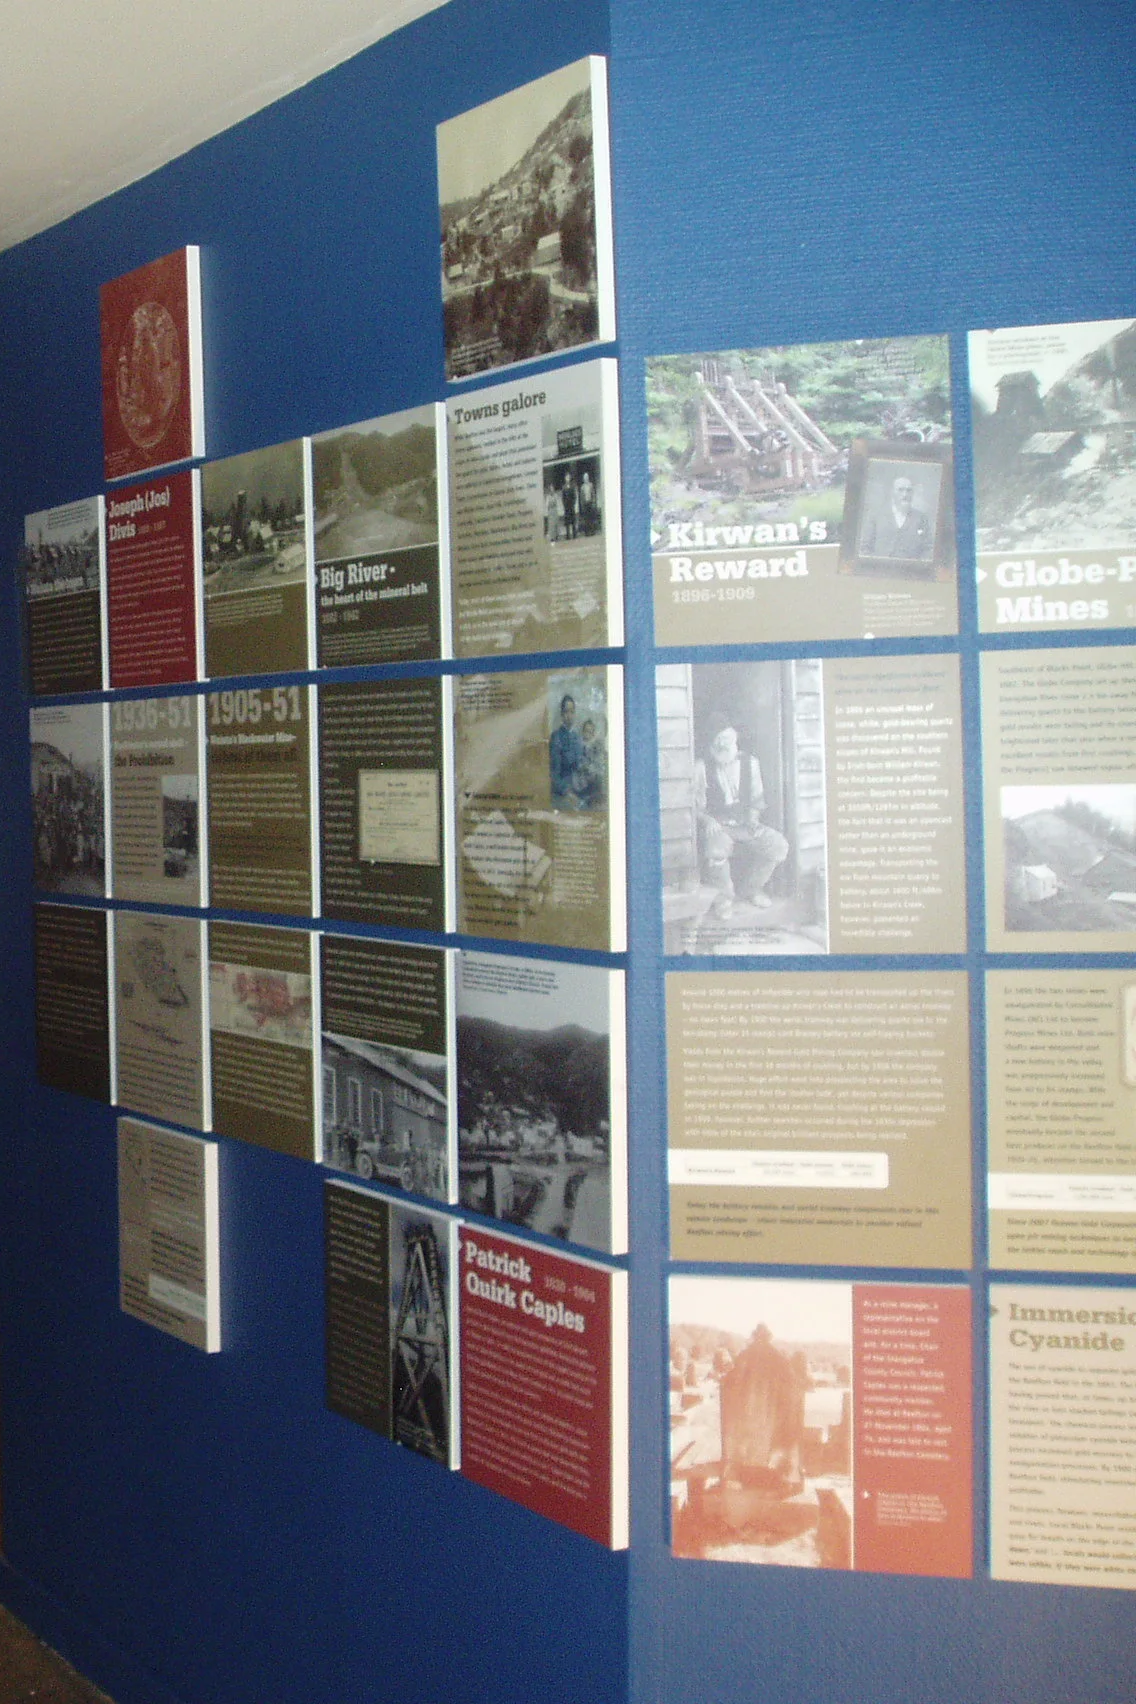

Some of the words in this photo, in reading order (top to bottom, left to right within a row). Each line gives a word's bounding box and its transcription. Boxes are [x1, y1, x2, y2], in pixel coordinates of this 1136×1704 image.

[455, 403, 499, 425] Towns
[503, 391, 546, 418] galore
[109, 494, 144, 518] Joseph
[109, 520, 137, 541] Divis
[668, 516, 828, 548] Kirwan's
[320, 566, 344, 592] Big
[347, 562, 388, 584] River
[669, 550, 809, 582] Reward
[672, 587, 756, 604] 1896-1909
[995, 595, 1109, 624] Mines
[112, 696, 192, 731] 1936-51
[209, 685, 301, 725] 1905-51
[465, 1240, 532, 1284] Patrick
[465, 1271, 517, 1310] Quirk
[520, 1290, 585, 1334] Caples
[1009, 1329, 1126, 1352] Cyanide
